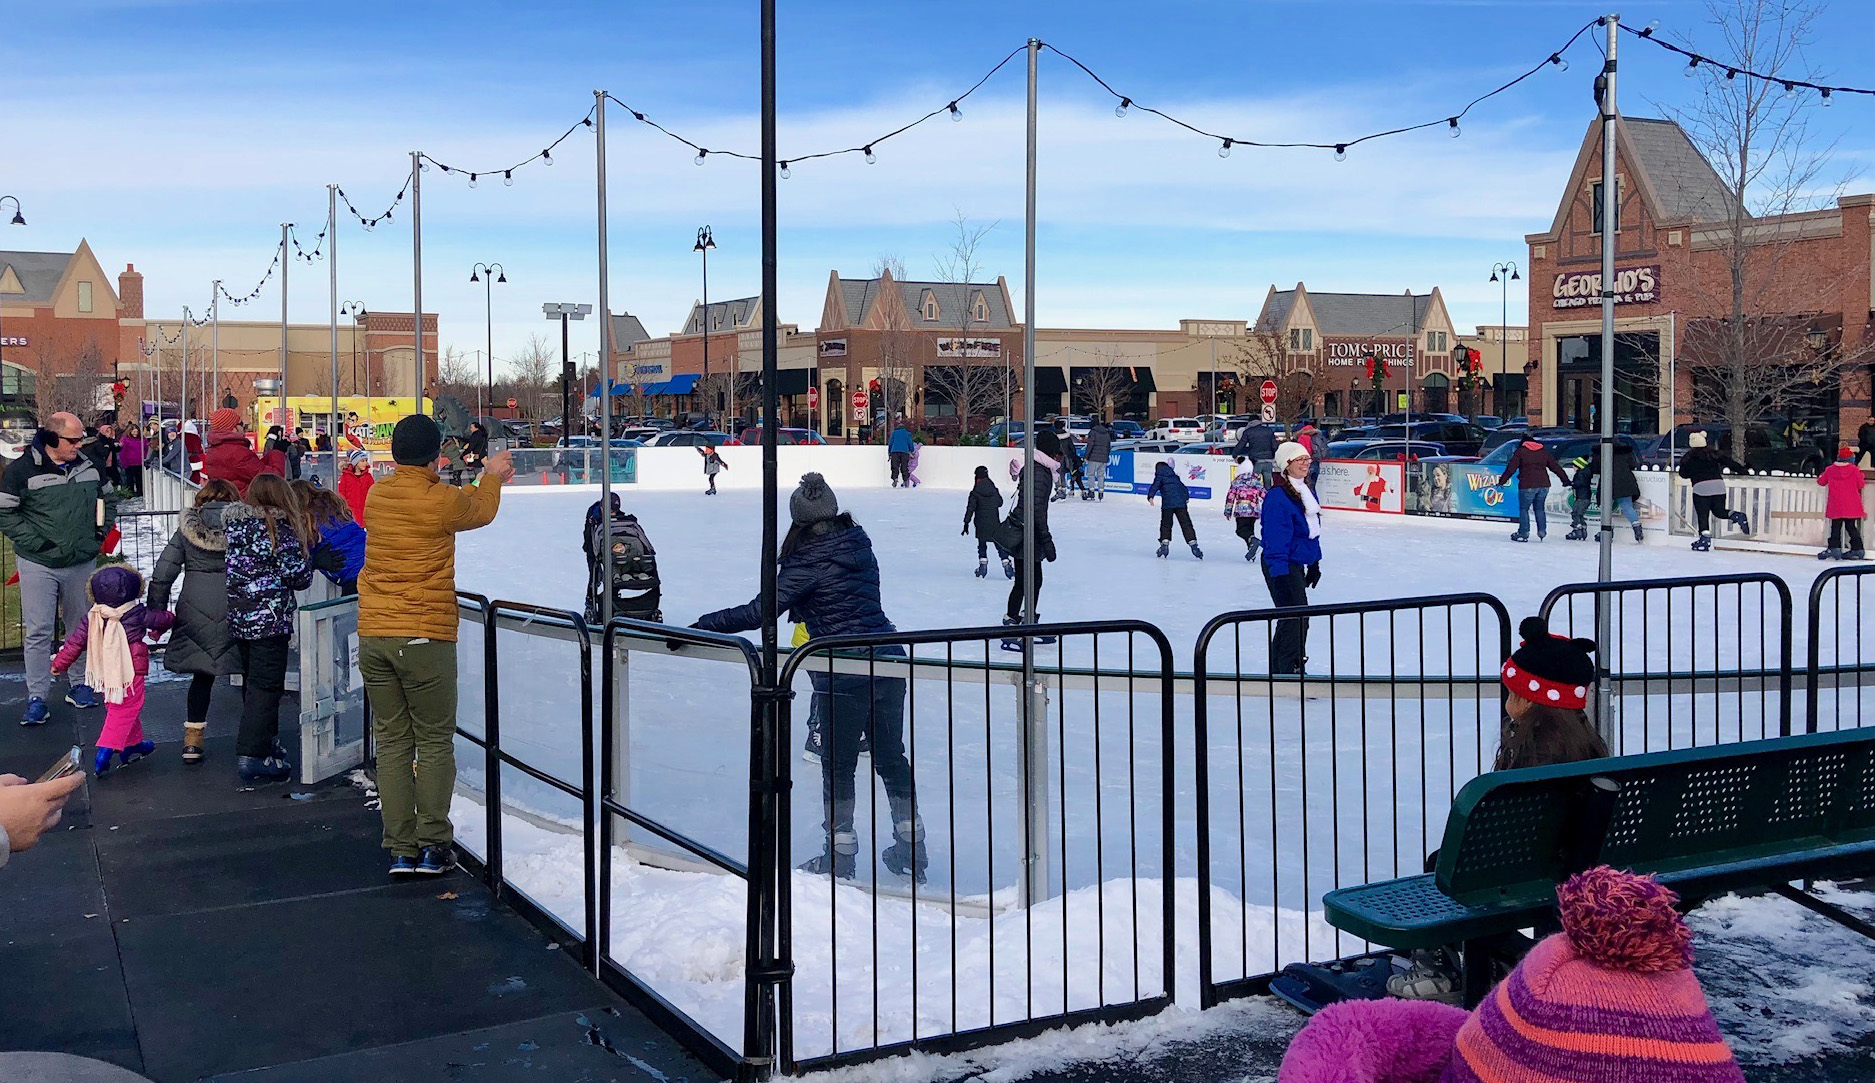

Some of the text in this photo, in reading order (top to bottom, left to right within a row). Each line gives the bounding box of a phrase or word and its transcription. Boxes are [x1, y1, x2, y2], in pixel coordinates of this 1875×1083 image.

[1553, 267, 1655, 297] GEORIO'S
[1328, 343, 1414, 357] TOMS-PRICE
[1328, 358, 1415, 366] HOME FUHINGS
[1261, 388, 1276, 397] STOP
